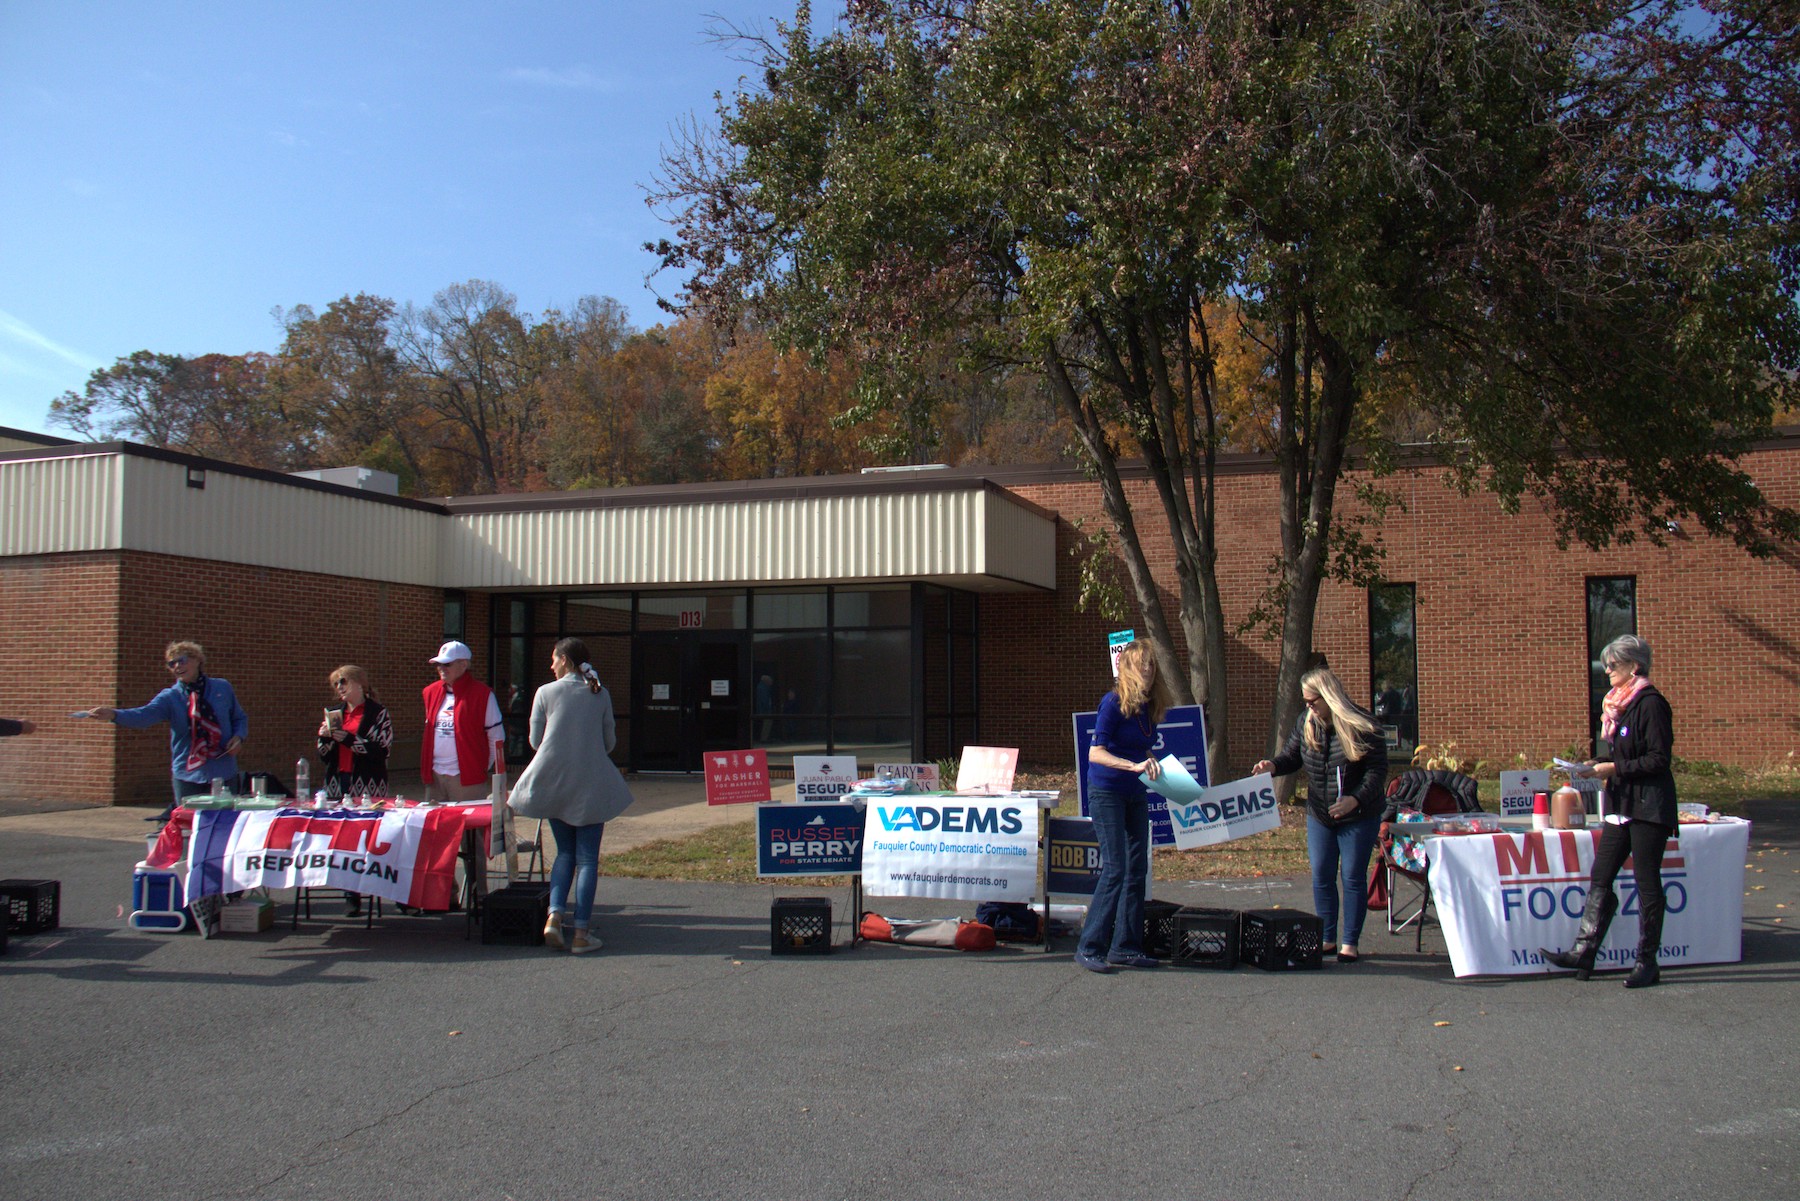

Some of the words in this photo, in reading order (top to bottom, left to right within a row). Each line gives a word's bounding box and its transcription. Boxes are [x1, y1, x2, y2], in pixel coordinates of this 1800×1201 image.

[681, 611, 701, 626] D13
[1111, 645, 1122, 654] NO
[713, 771, 761, 782] WASHER
[825, 775, 852, 783] PABLO
[1171, 787, 1276, 828] VADEMS
[1502, 795, 1534, 808] SEGU
[877, 806, 1023, 835] VADEMS
[1203, 823, 1222, 831] COUNTY
[1222, 816, 1250, 827] DEMOCRATIC
[1249, 809, 1273, 821] COMMITTEE
[771, 826, 860, 841] RUSSET
[771, 840, 860, 857] PERRY
[873, 840, 908, 853] Fauquier
[909, 841, 938, 855] County
[939, 842, 984, 855] Democratic
[985, 843, 1028, 857] Committee
[1051, 845, 1085, 868] ROB
[246, 854, 399, 884] REPUBLICAN
[890, 871, 1008, 888] www.fauquierdemocrats.org
[1595, 944, 1690, 965] Supeisor
